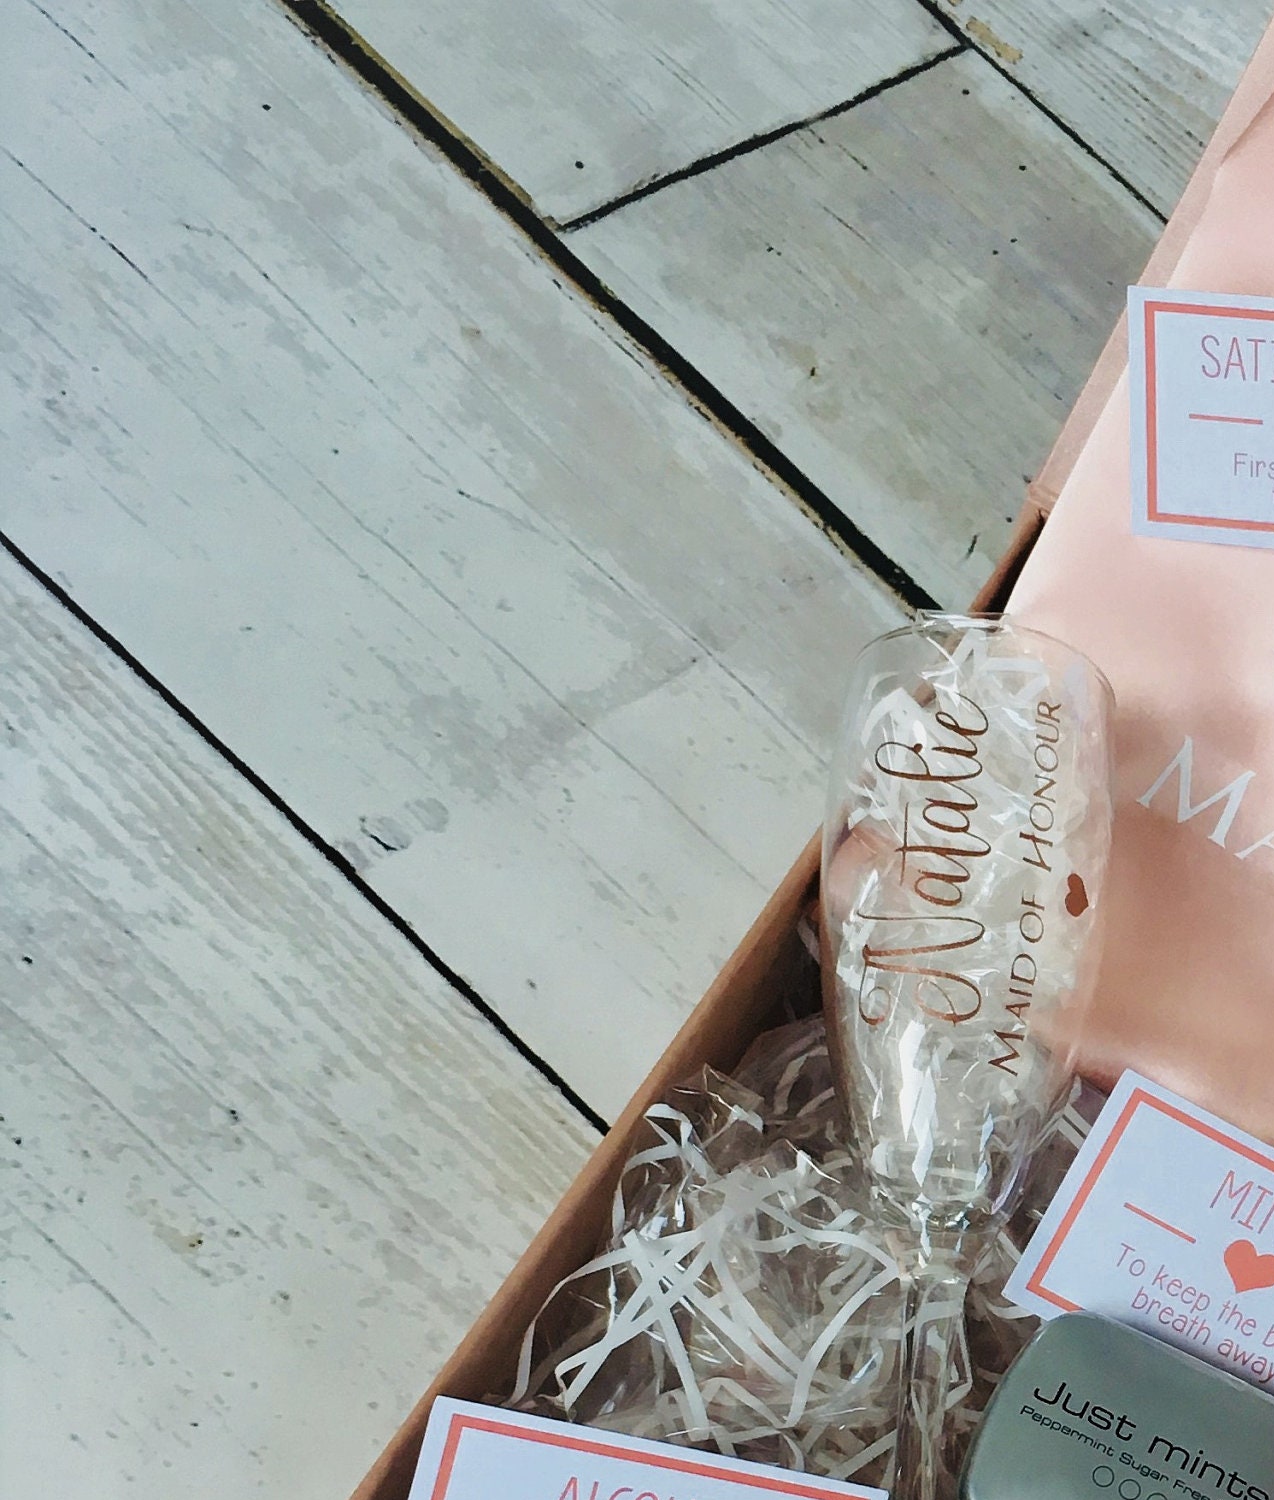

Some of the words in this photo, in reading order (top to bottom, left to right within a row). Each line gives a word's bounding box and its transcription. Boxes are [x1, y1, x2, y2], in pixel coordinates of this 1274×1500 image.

[1019, 701, 1062, 873] HONOUR
[857, 691, 992, 1027] Natalie
[1019, 890, 1046, 943] OF
[988, 953, 1038, 1076] MAID
[1116, 1242, 1146, 1277] To
[1151, 1264, 1211, 1314] keep
[1217, 1300, 1257, 1337] the
[1131, 1286, 1212, 1346] breath
[1020, 1405, 1114, 1457] Peppermint
[1119, 1452, 1170, 1482] Sugar
[1033, 1382, 1137, 1441] Just
